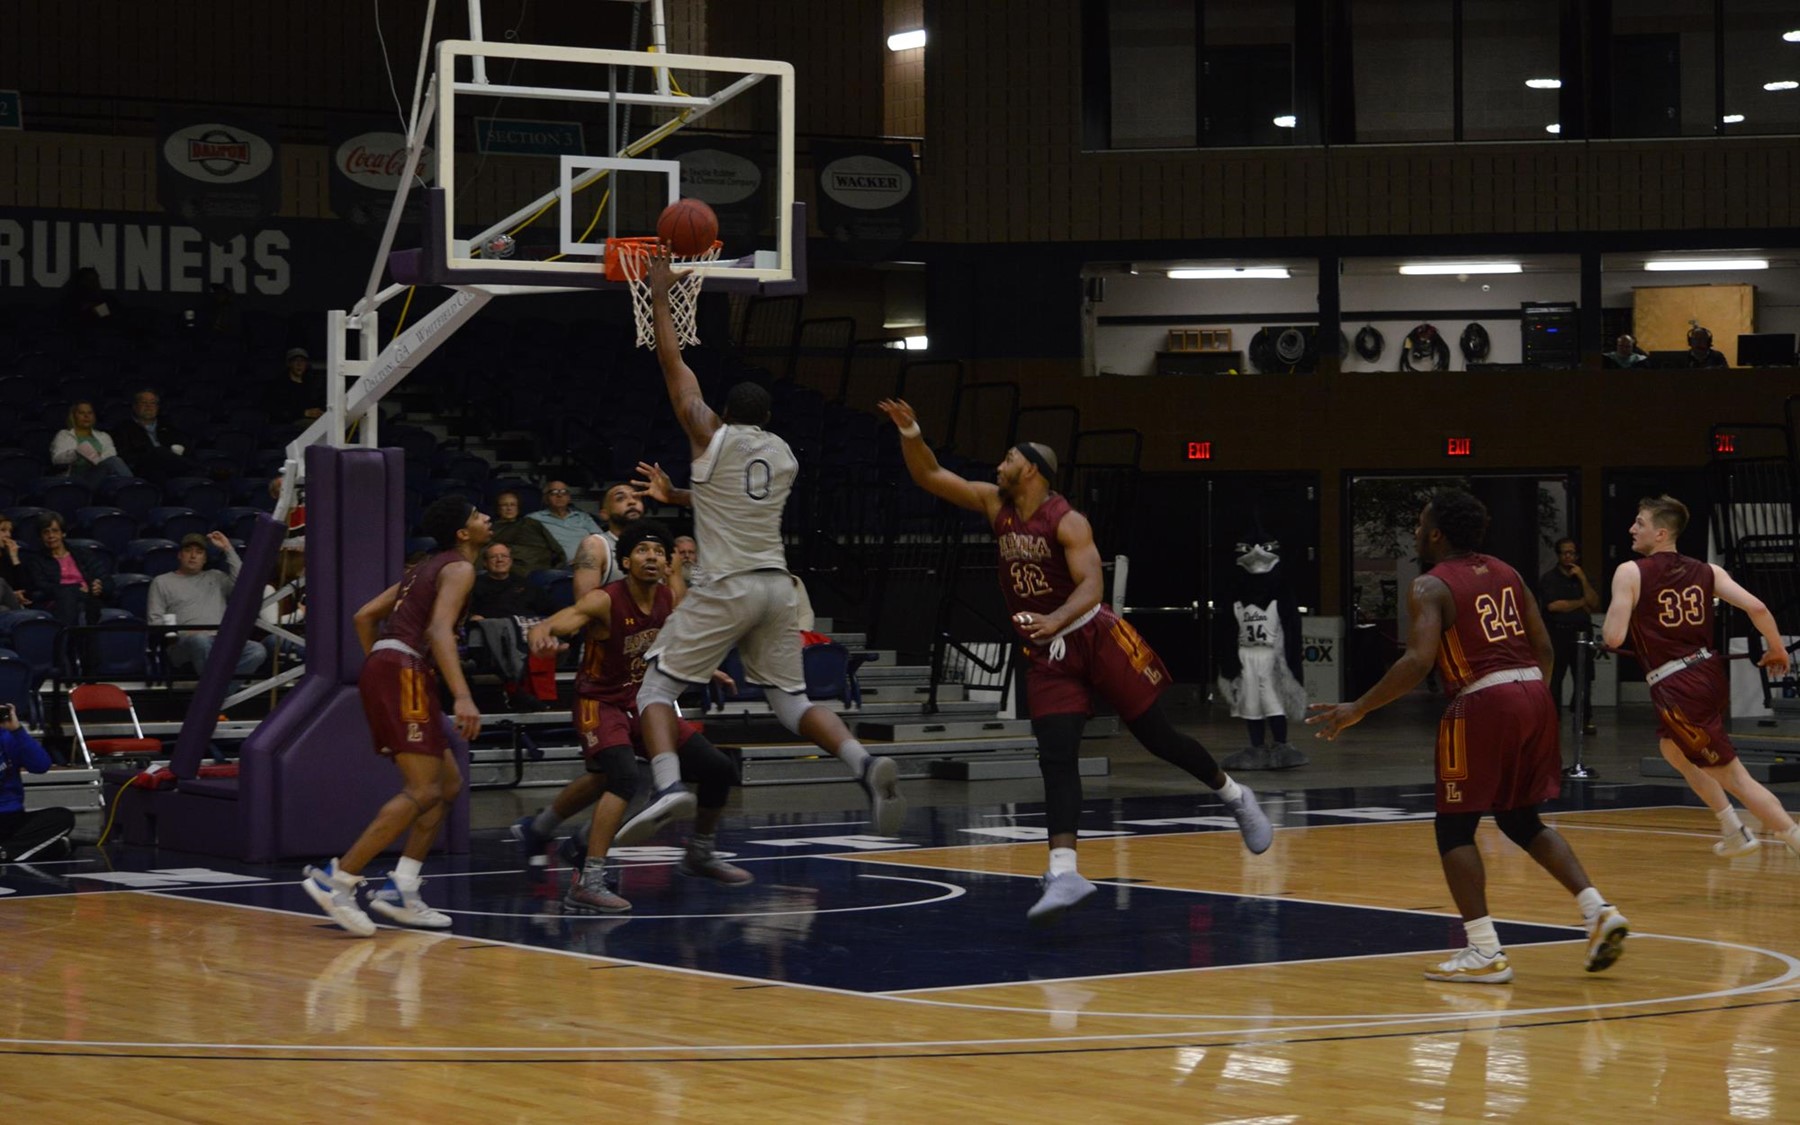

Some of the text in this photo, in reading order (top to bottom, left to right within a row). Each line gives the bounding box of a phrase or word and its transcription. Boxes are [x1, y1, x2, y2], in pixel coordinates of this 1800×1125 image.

[487, 130, 573, 146] SECTION 3
[346, 146, 427, 176] Coca-Coa
[836, 175, 898, 189] WACKER
[0, 218, 291, 296] RUNNERS
[1188, 442, 1211, 459] EXIT
[1448, 438, 1471, 455] EXIT
[745, 458, 771, 501] 0
[1010, 562, 1053, 598] 32
[1475, 586, 1525, 643] 24
[1658, 585, 1706, 627] 33
[1246, 625, 1267, 642] 34
[1302, 646, 1333, 663] OX
